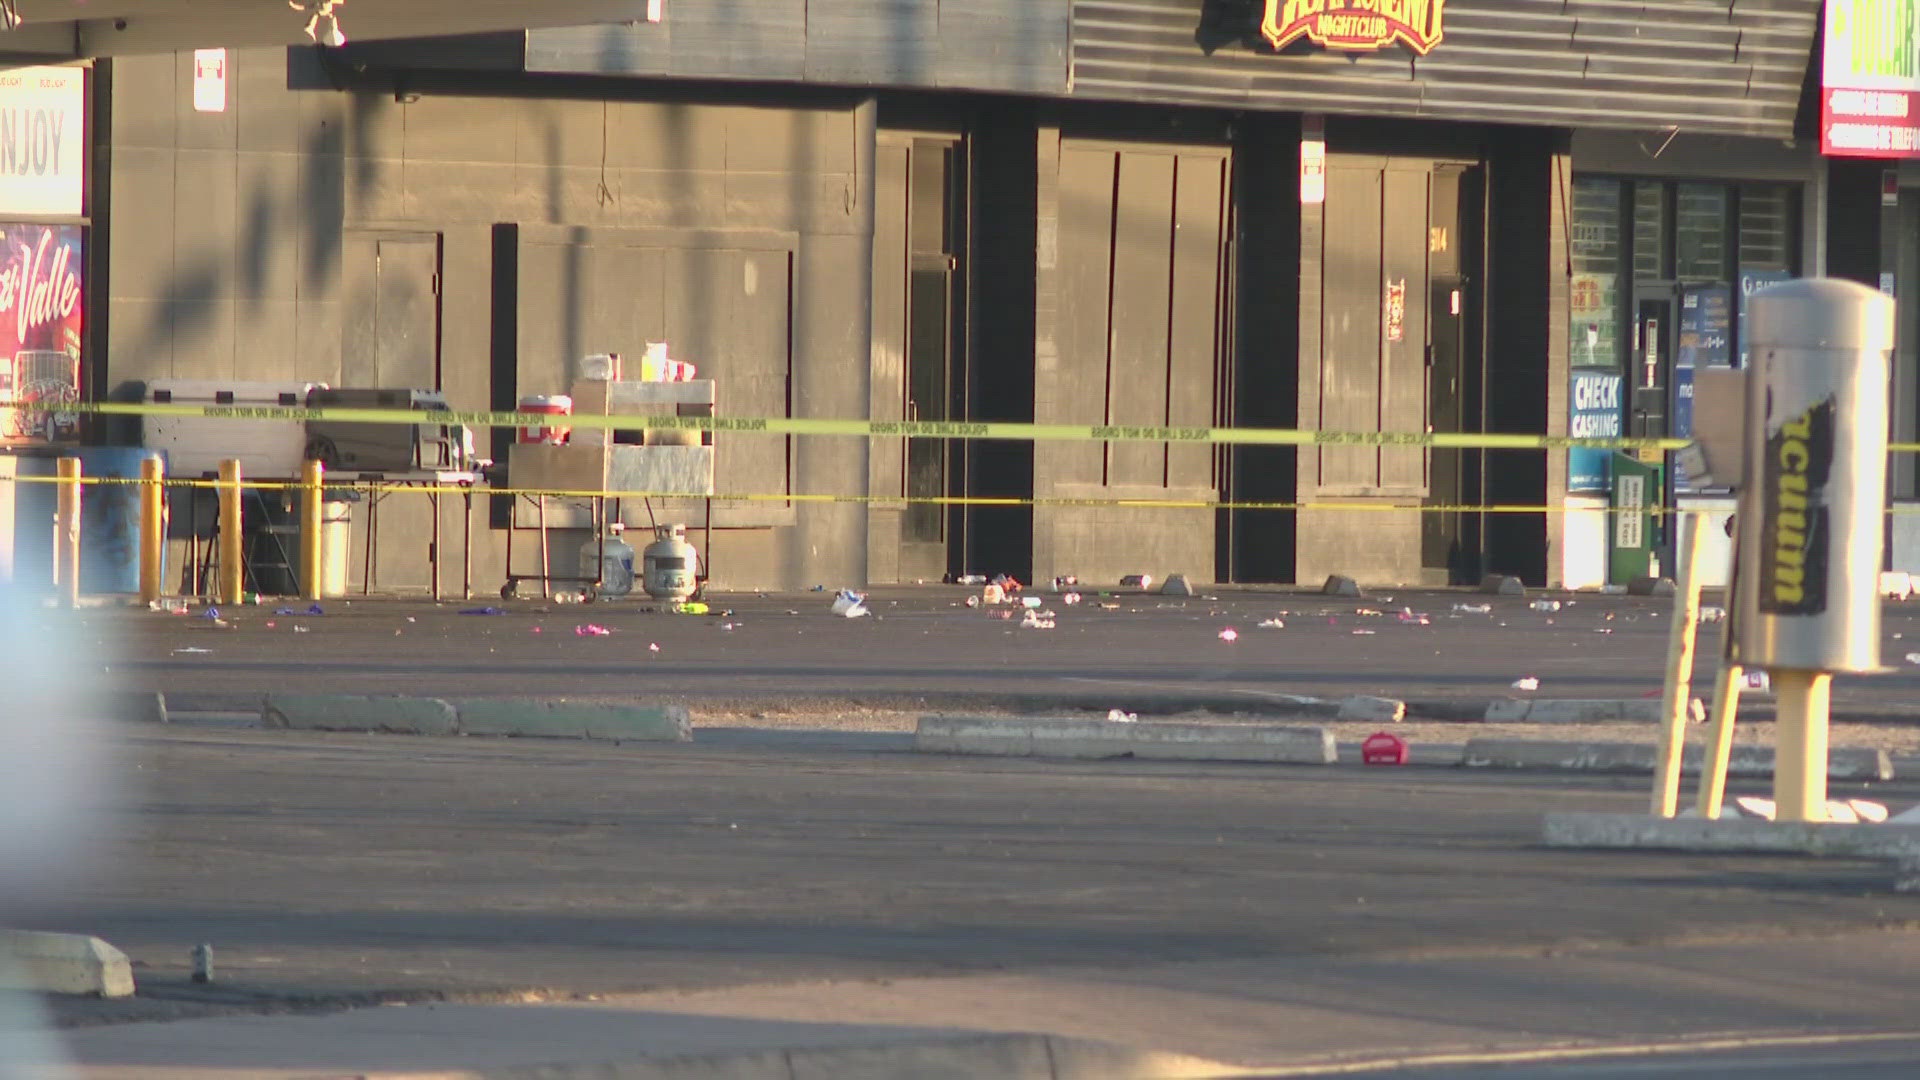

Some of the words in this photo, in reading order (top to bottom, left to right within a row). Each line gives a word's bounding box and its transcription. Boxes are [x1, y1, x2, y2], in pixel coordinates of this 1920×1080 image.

[1317, 14, 1387, 37] NIGHTCLUB
[1, 106, 65, 176] NJOY
[18, 229, 79, 344] Valle
[1575, 377, 1619, 410] CHECK
[1572, 413, 1618, 438] CASHING
